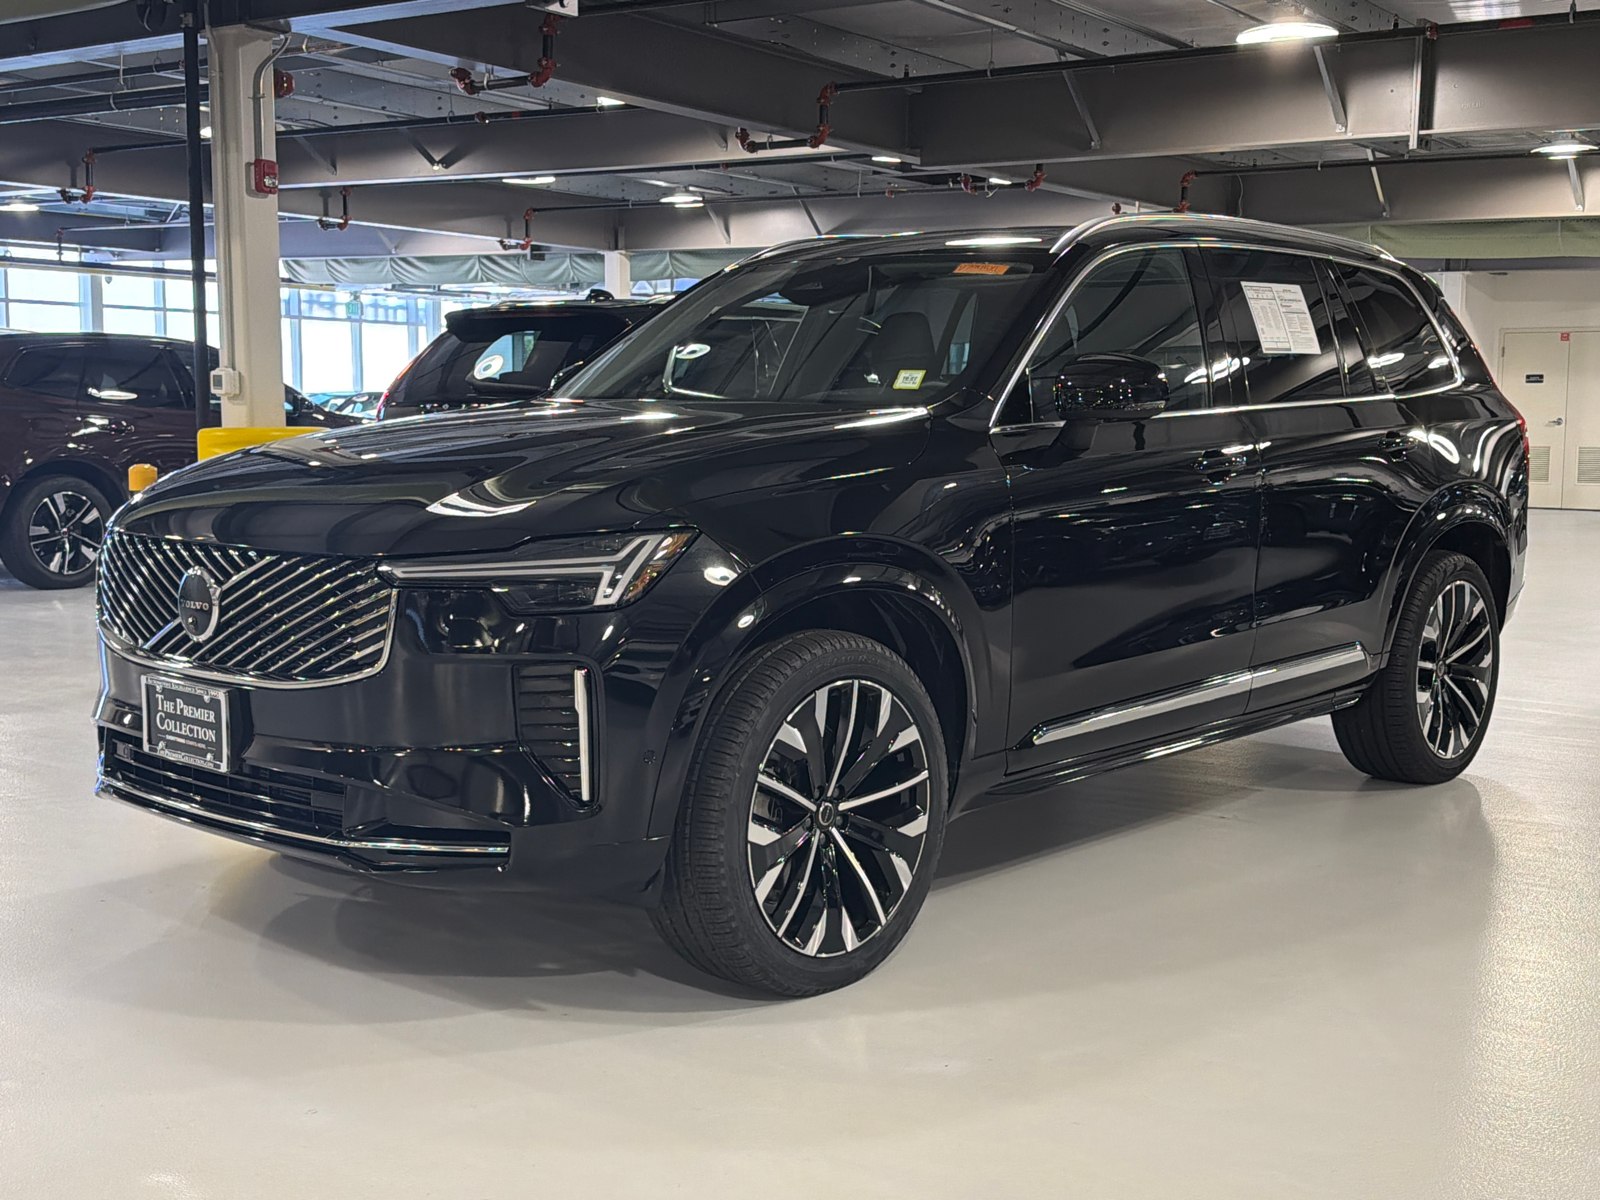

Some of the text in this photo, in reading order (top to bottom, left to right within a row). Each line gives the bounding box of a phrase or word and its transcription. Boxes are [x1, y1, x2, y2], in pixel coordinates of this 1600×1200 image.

[181, 599, 210, 611] VOLVO
[156, 694, 216, 724] THE PREMIER
[156, 712, 216, 743] COLLECTION
